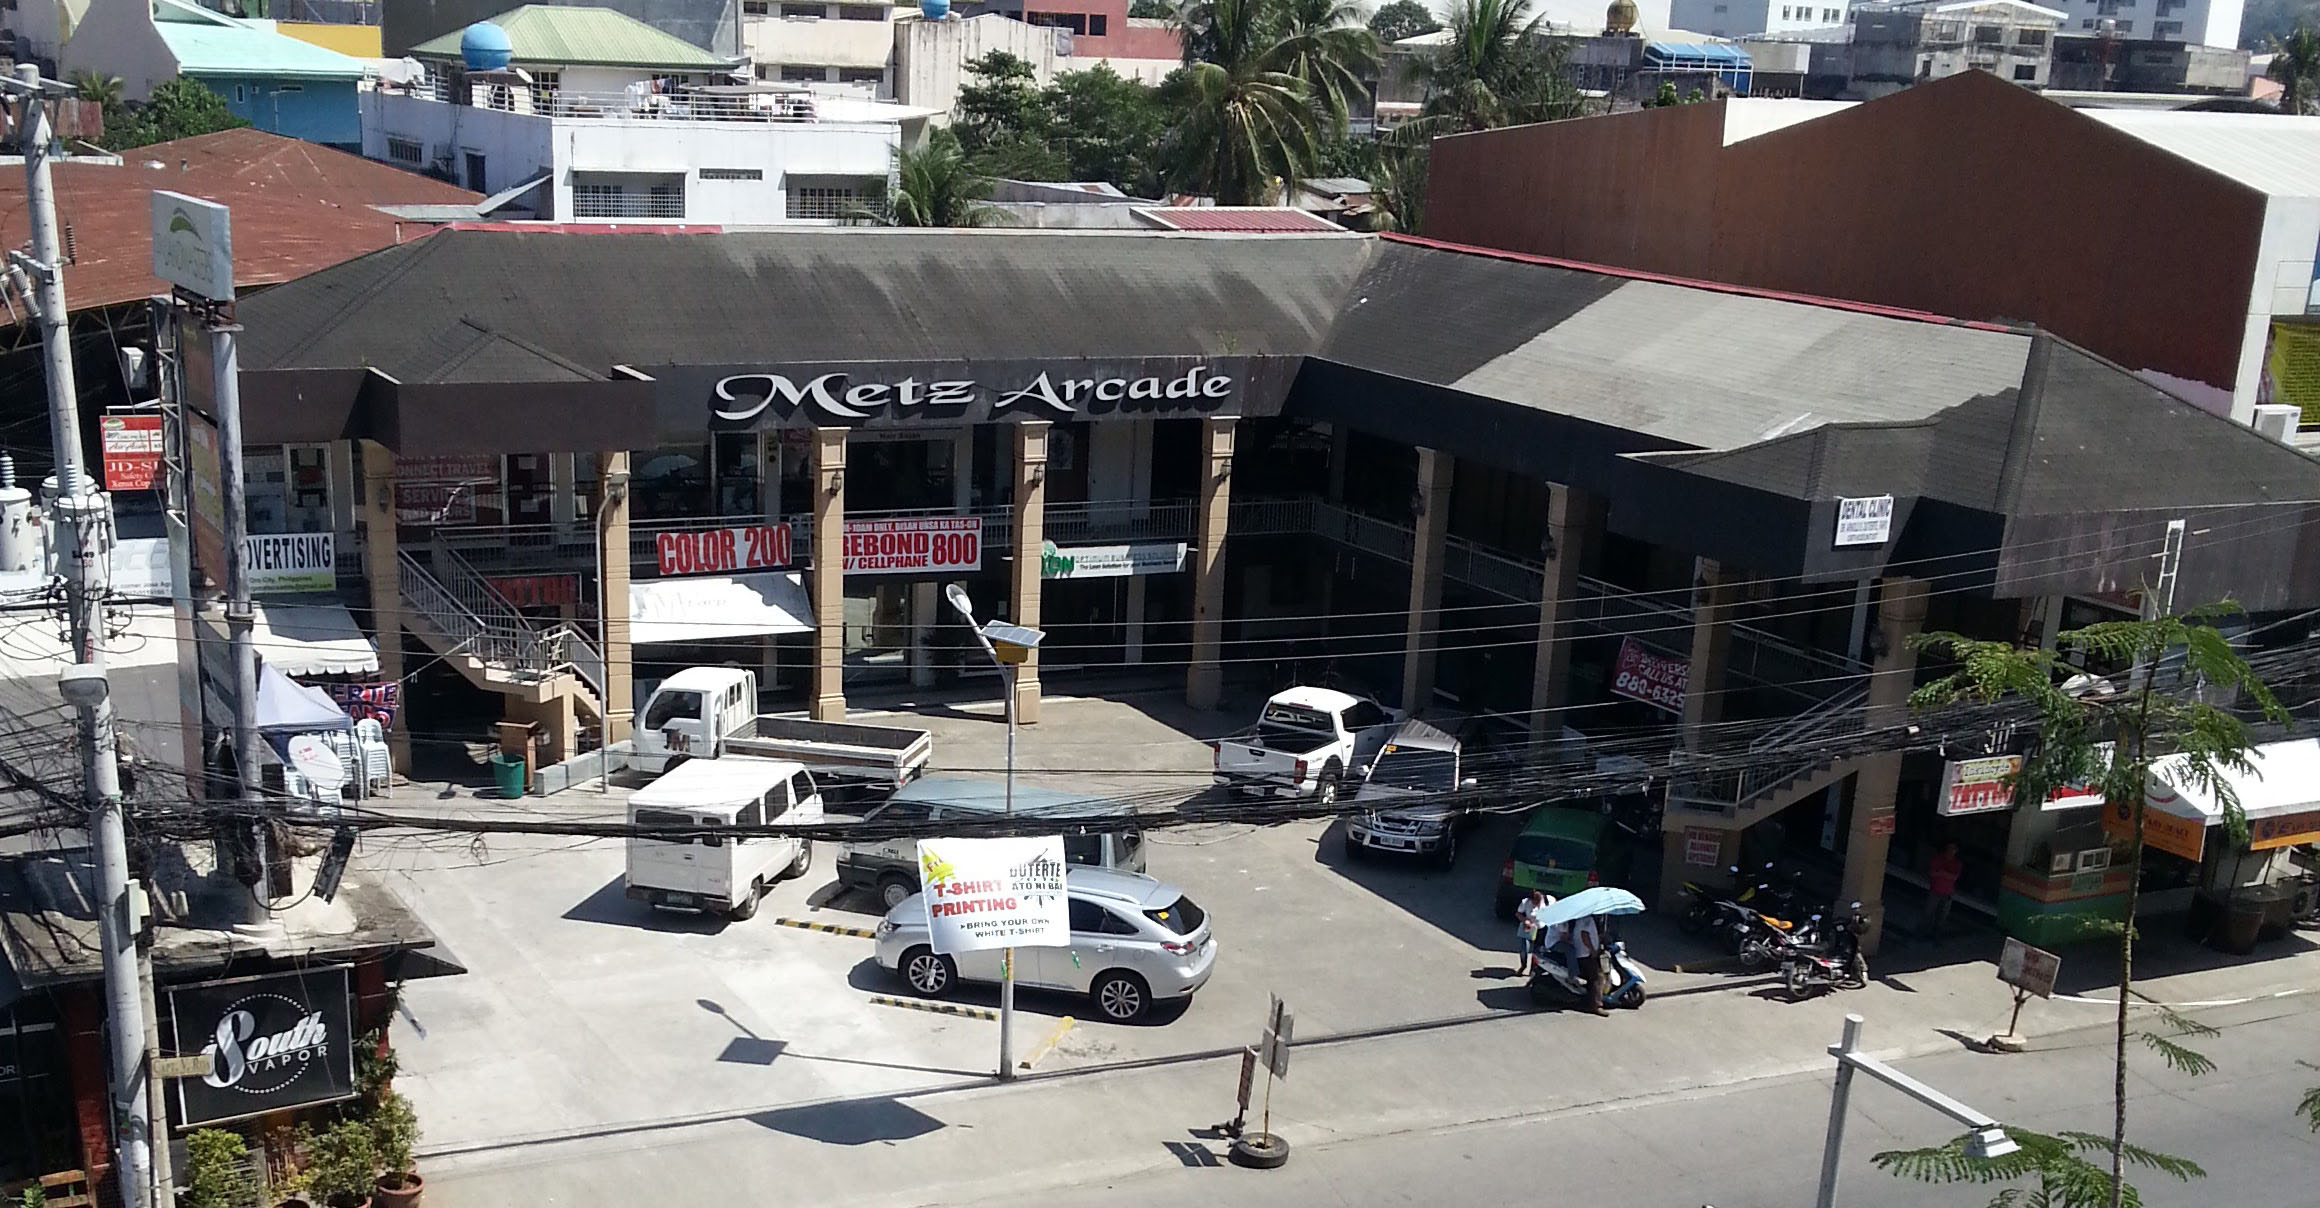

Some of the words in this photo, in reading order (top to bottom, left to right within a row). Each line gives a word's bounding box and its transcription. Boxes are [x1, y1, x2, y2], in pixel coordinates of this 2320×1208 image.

[714, 372, 976, 421] Metz
[994, 365, 1232, 413] Arcade
[1841, 500, 1867, 520] DENTAL
[1868, 498, 1892, 518] CLINIC
[656, 528, 738, 576] COLOR
[744, 522, 792, 568] 200
[931, 532, 978, 566] 800
[857, 554, 929, 570] CELLPHANE
[1009, 862, 1061, 878] DUTERTE
[933, 879, 1003, 898] T-SHIRT
[931, 897, 1018, 918] PRINTING
[966, 921, 998, 930] BRING
[1001, 918, 1028, 927] YOUR
[975, 928, 1006, 938] WHITE
[201, 1010, 328, 1088] South
[248, 1044, 328, 1075] VAPOR
